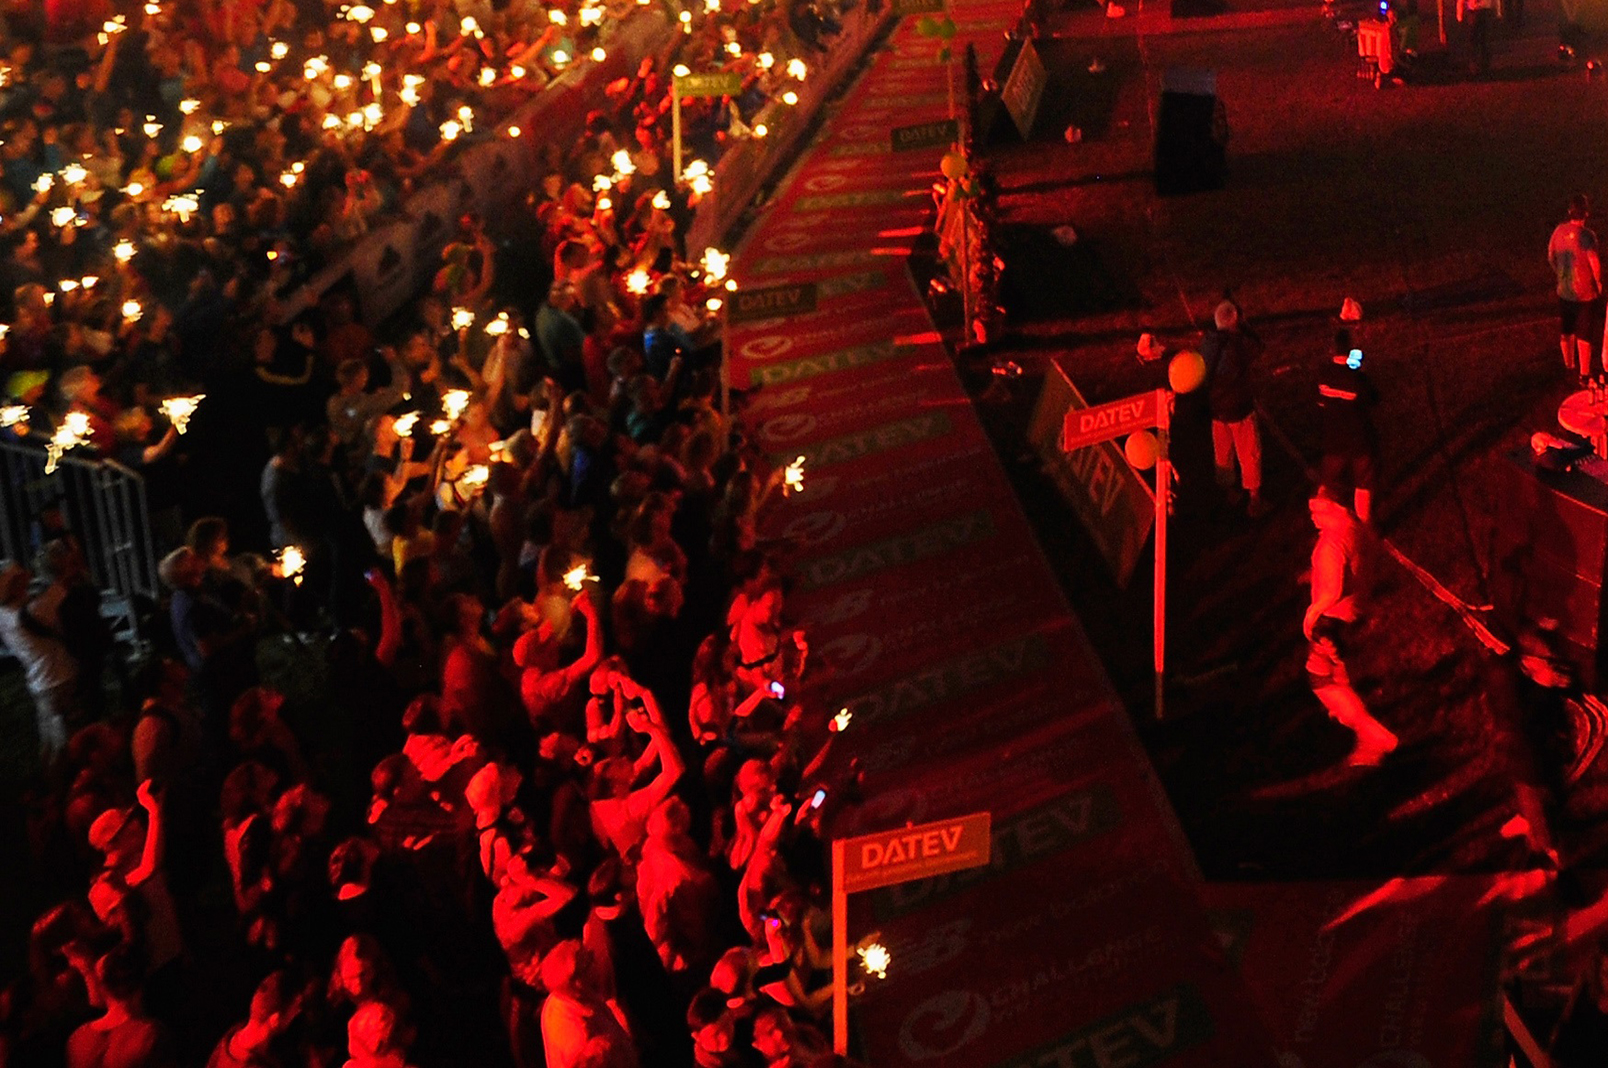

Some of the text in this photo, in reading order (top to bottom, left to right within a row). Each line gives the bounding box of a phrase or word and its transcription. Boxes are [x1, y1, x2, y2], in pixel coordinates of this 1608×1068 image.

[737, 288, 801, 312] DATEV
[1079, 399, 1146, 433] DATEV
[809, 519, 980, 583] DATEV
[861, 825, 965, 869] DATEV
